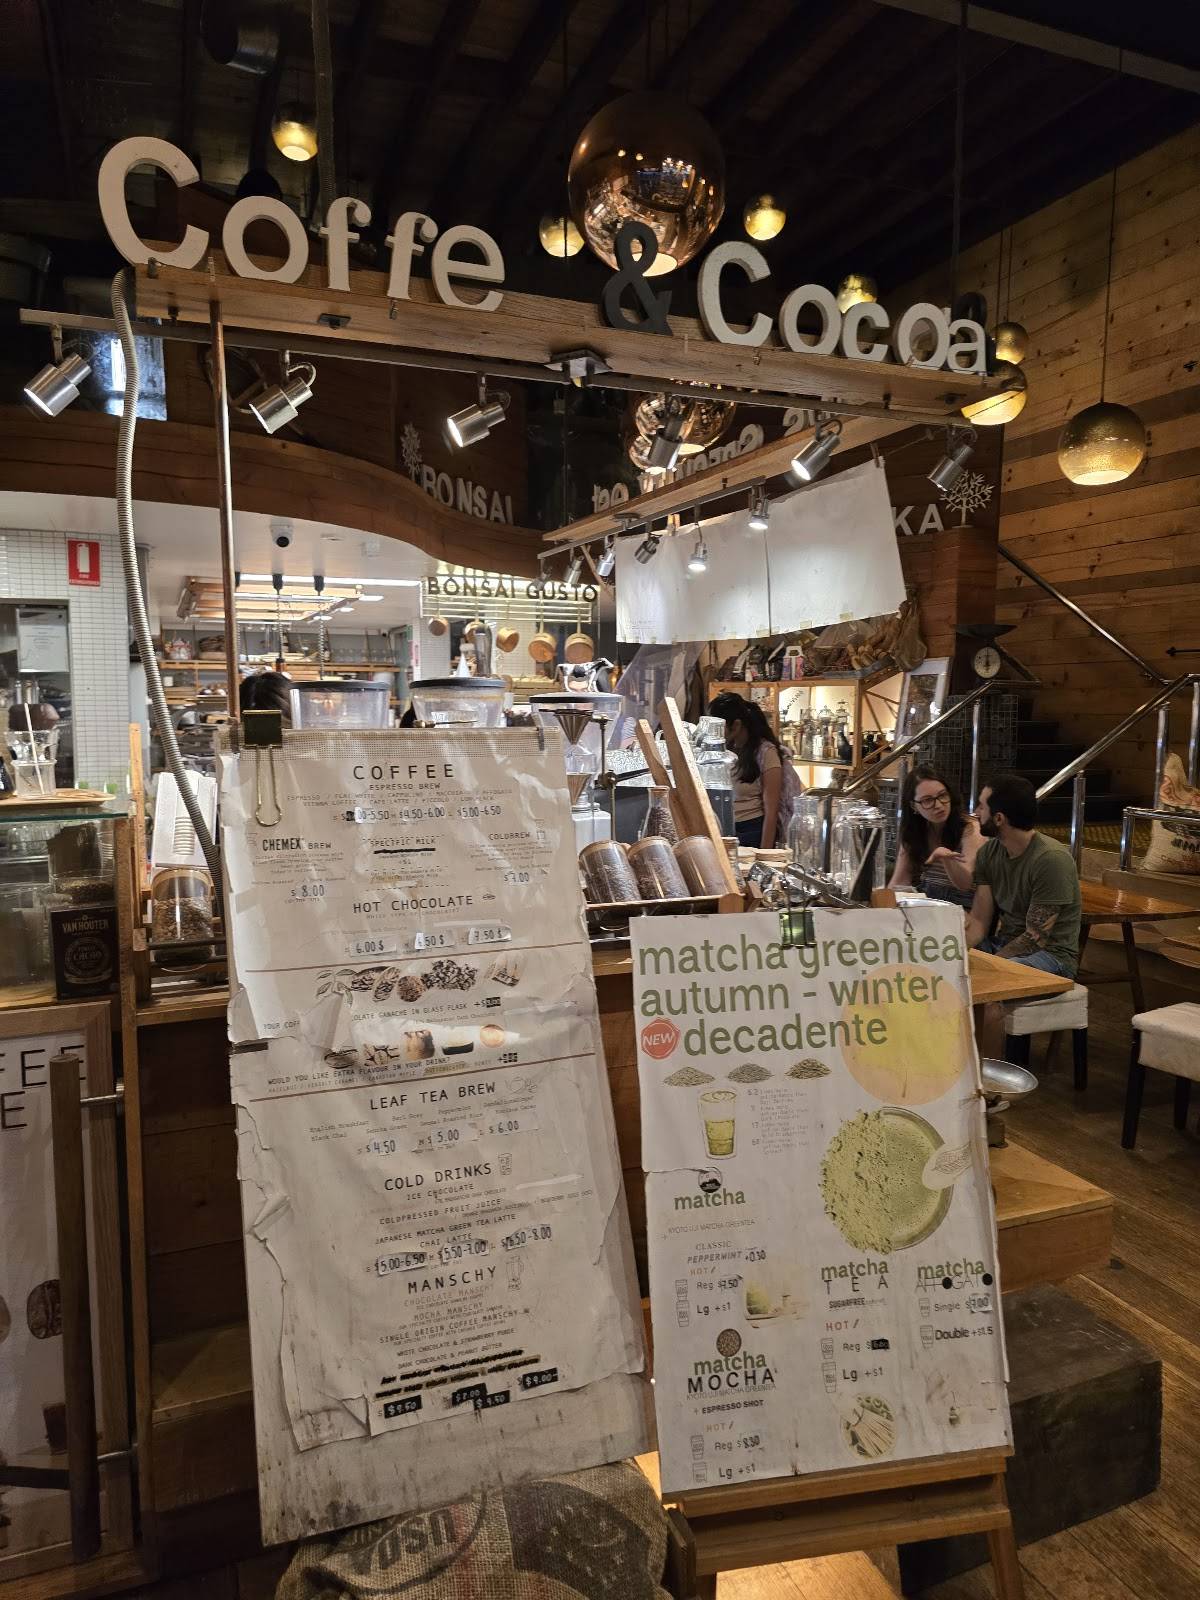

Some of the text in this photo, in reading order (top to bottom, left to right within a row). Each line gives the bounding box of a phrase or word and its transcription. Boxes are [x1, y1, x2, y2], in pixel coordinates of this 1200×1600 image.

[97, 136, 988, 377] Coffe & Cocoa
[421, 465, 514, 525] BONSAI
[428, 577, 598, 602] BONSAI GUSTO
[353, 764, 454, 780] COFFEE
[369, 782, 441, 791] ESPRESSO BREW
[488, 832, 530, 841] COLDBREW
[263, 838, 332, 851] CHEMEX BREW
[301, 885, 325, 897] 8.00
[353, 895, 473, 913] HOT CHOCOLATE
[638, 934, 963, 979] matcha greentea
[640, 969, 943, 1016] autumn - winter
[446, 1003, 468, 1011] FLASK
[642, 1033, 674, 1047] NEW
[683, 1013, 888, 1057] decadente
[295, 1073, 309, 1081] YOU
[312, 1072, 329, 1080] LIKE
[359, 1065, 389, 1075] FLAVOUR
[370, 1082, 496, 1110] LEAF TEA BREW
[437, 1129, 460, 1143] 5.00
[384, 1163, 492, 1191] COLD DRINKS
[407, 1192, 422, 1201] ICE
[427, 1183, 474, 1197] CHOCOLATE
[674, 1188, 746, 1211] matcha
[379, 1209, 439, 1225] COLDPRESSED
[444, 1203, 470, 1214] FRUIT
[375, 1213, 517, 1245] JAPANESE MATCHA GREEN TEA LATTE
[420, 1233, 472, 1248] CHAI LATTE
[695, 1240, 732, 1250] CLASSIC
[687, 1251, 743, 1264] PEPPERMINT
[689, 1268, 707, 1276] HOT
[821, 1258, 986, 1280] matcha matcha
[408, 1266, 497, 1294] MANSCHY
[696, 1280, 714, 1290] Reg
[824, 1275, 889, 1294] TEA
[413, 1302, 483, 1321] MOCHA MANSCHY
[696, 1304, 710, 1316] Lg
[934, 1302, 961, 1313] Single
[379, 1332, 409, 1344] SINGLE
[415, 1326, 444, 1336] ORIGIN
[449, 1319, 478, 1330] COFFEE
[482, 1310, 518, 1322] MANSCHY
[826, 1321, 849, 1331] HOT
[935, 1328, 970, 1341] Double
[843, 1342, 861, 1352] Reg
[693, 1351, 767, 1376] matcha
[688, 1368, 776, 1394] MOCHA
[842, 1369, 858, 1381] Lg
[702, 1402, 742, 1414] ESPRESSO
[743, 1399, 765, 1408] SHOT
[706, 1422, 726, 1432] HOT
[714, 1441, 733, 1451] Reg
[718, 1466, 733, 1479] Lg
